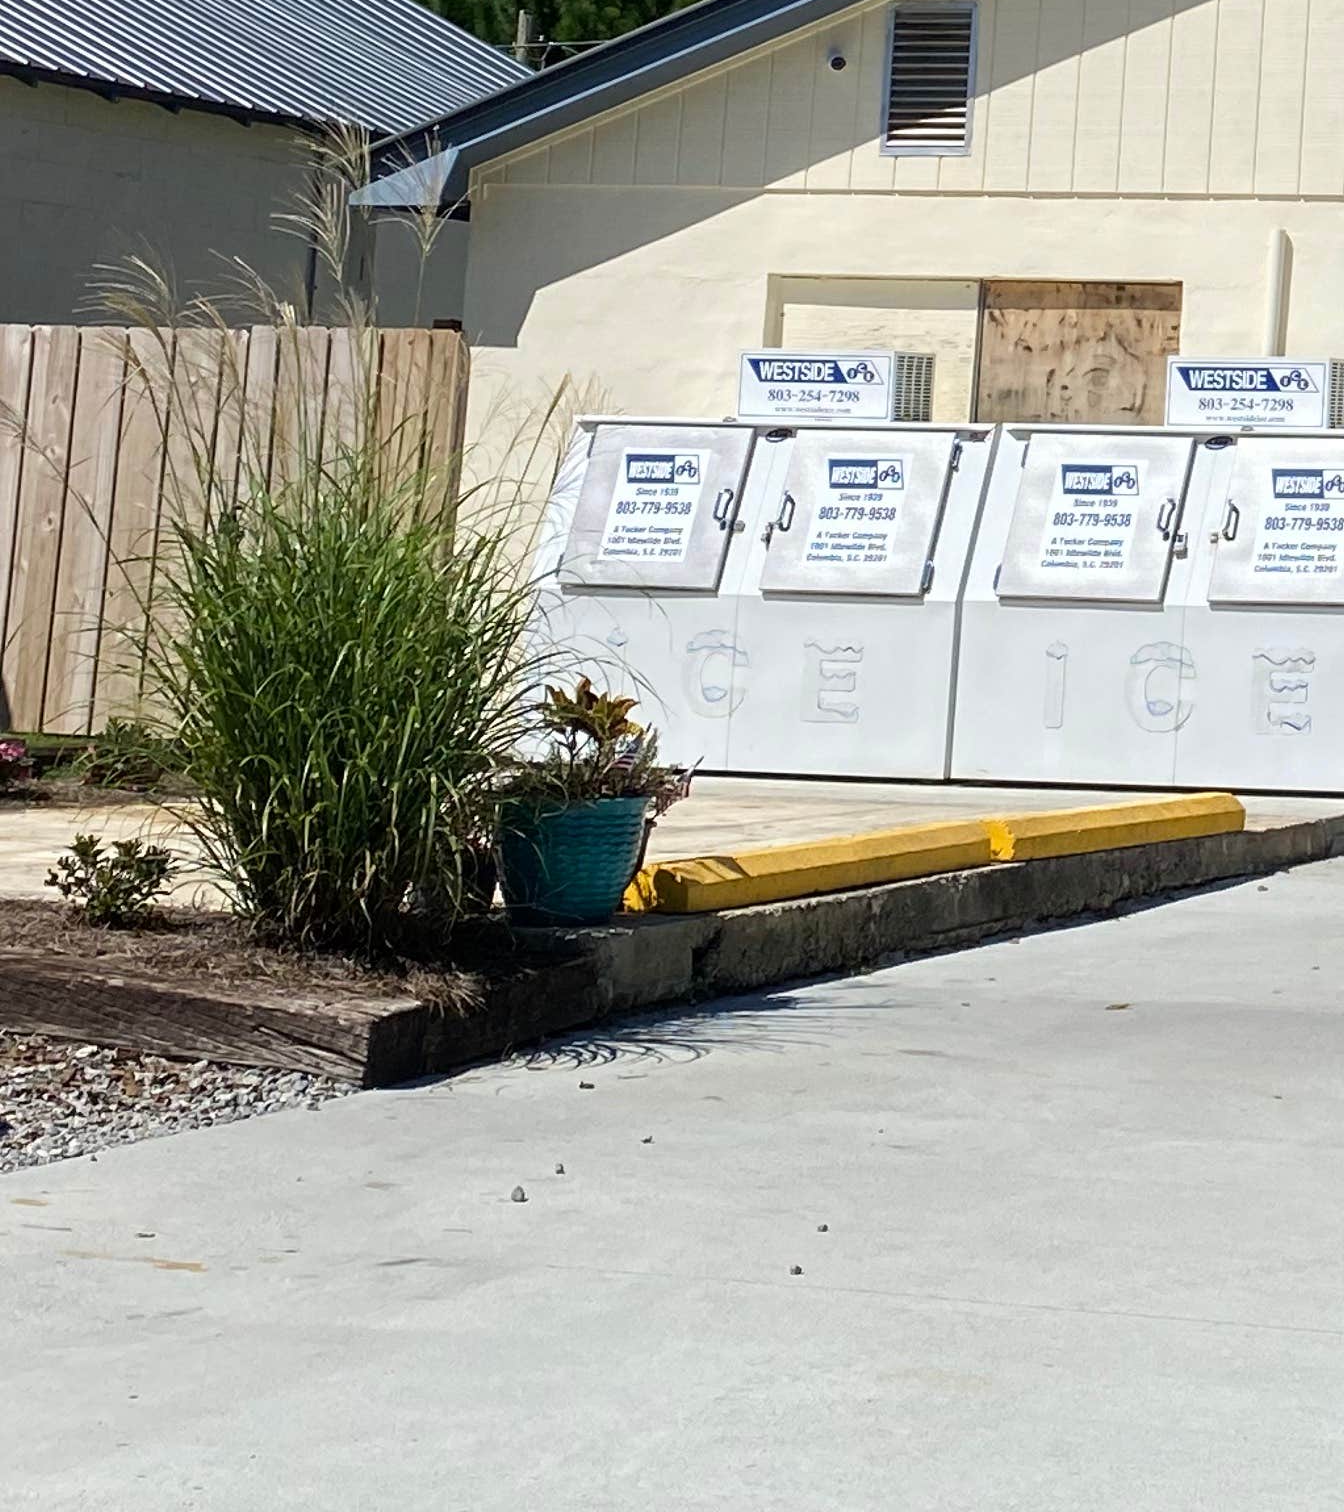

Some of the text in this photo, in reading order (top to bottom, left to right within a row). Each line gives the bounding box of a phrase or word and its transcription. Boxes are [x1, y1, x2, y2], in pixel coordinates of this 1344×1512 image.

[759, 361, 835, 381] WESTSIDE
[1188, 369, 1268, 390] WESTSIDE
[767, 389, 861, 403] 803-254-7298
[1198, 398, 1294, 412] 803-254-7298
[628, 461, 674, 479] WESTSIDE
[831, 466, 878, 484] WESTSIDE
[1064, 471, 1112, 490] WESTSIDE
[1276, 476, 1323, 494] WESTSIDE
[635, 487, 658, 496] Since
[838, 493, 861, 501] Since
[615, 500, 692, 515] 803-779-9538
[1073, 498, 1096, 507] Since
[1285, 503, 1307, 512] Since
[818, 506, 897, 521] 803-779-9538
[1053, 512, 1132, 527] 803-779-9538
[1264, 516, 1344, 531] 803-779-9538
[1044, 641, 1316, 736] ICE
